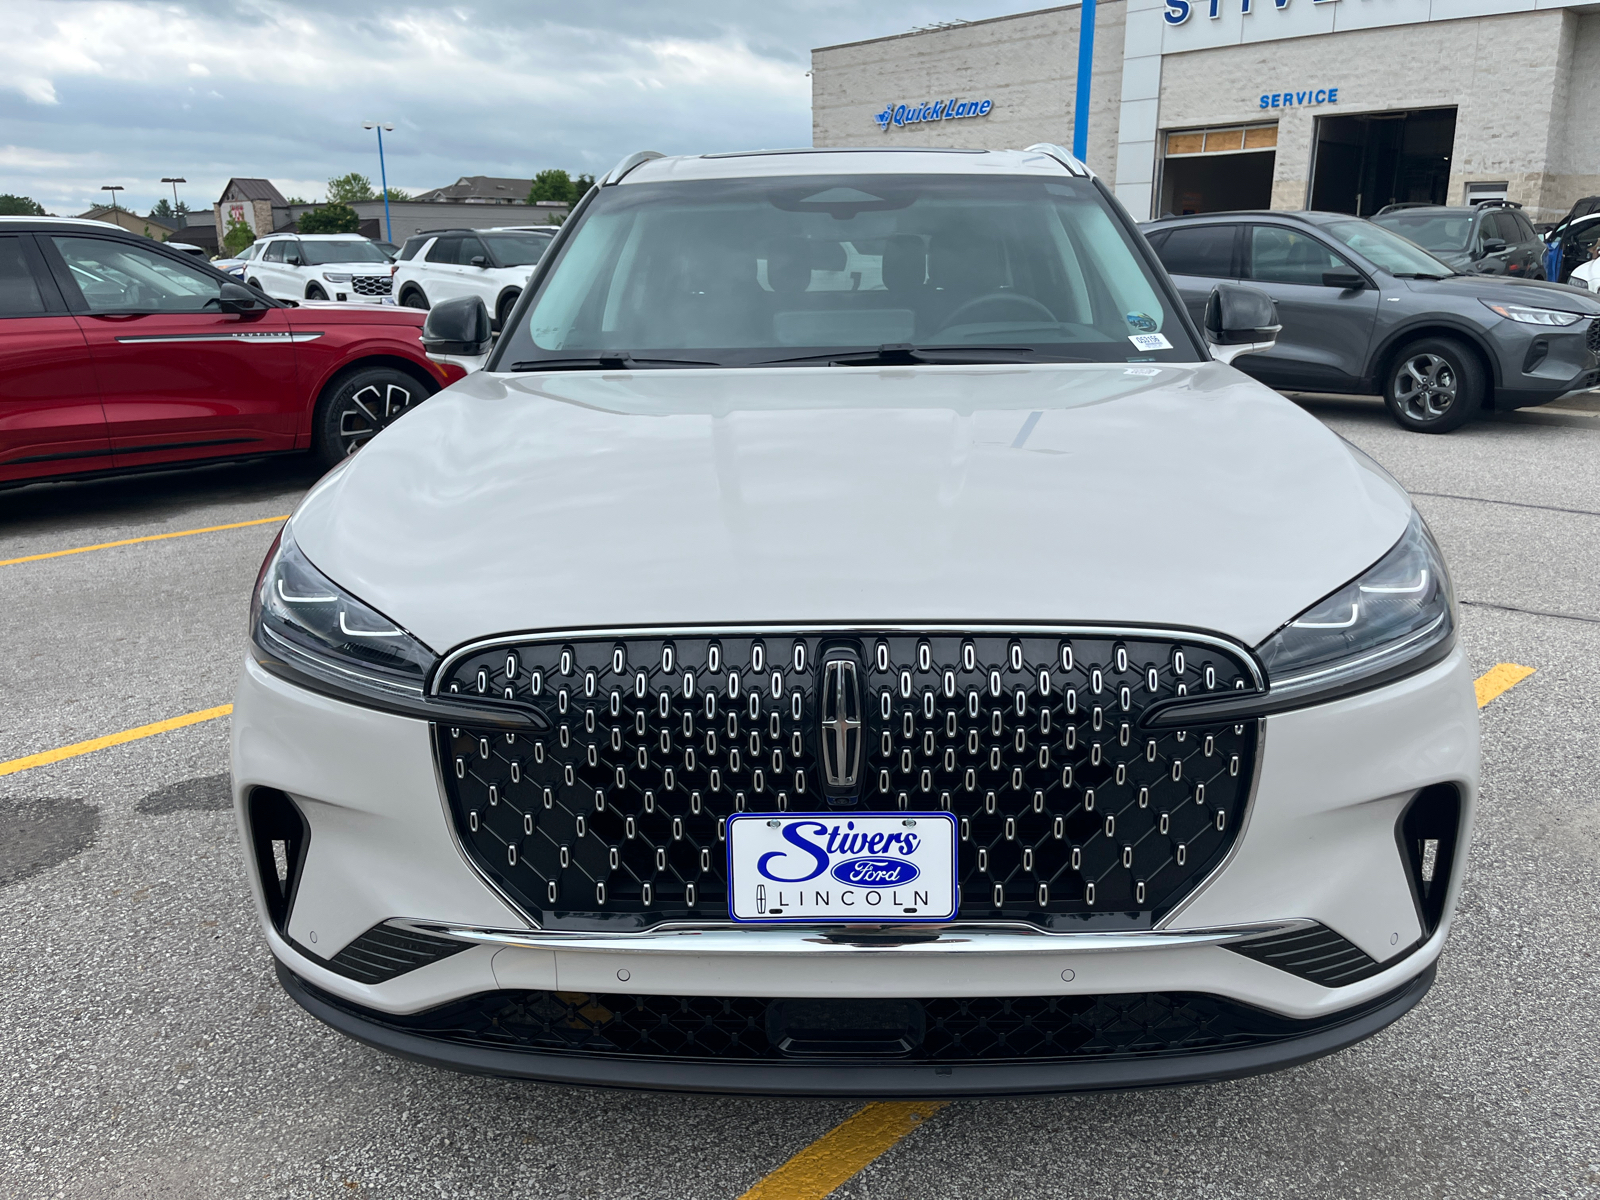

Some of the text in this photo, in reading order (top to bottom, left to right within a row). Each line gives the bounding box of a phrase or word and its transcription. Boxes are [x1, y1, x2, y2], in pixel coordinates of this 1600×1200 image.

[1259, 88, 1339, 109] SERVICE
[893, 98, 992, 126] Quick Lane
[757, 821, 922, 883] Stivers
[850, 861, 900, 882] Ford
[778, 890, 929, 907] LINCOLN
